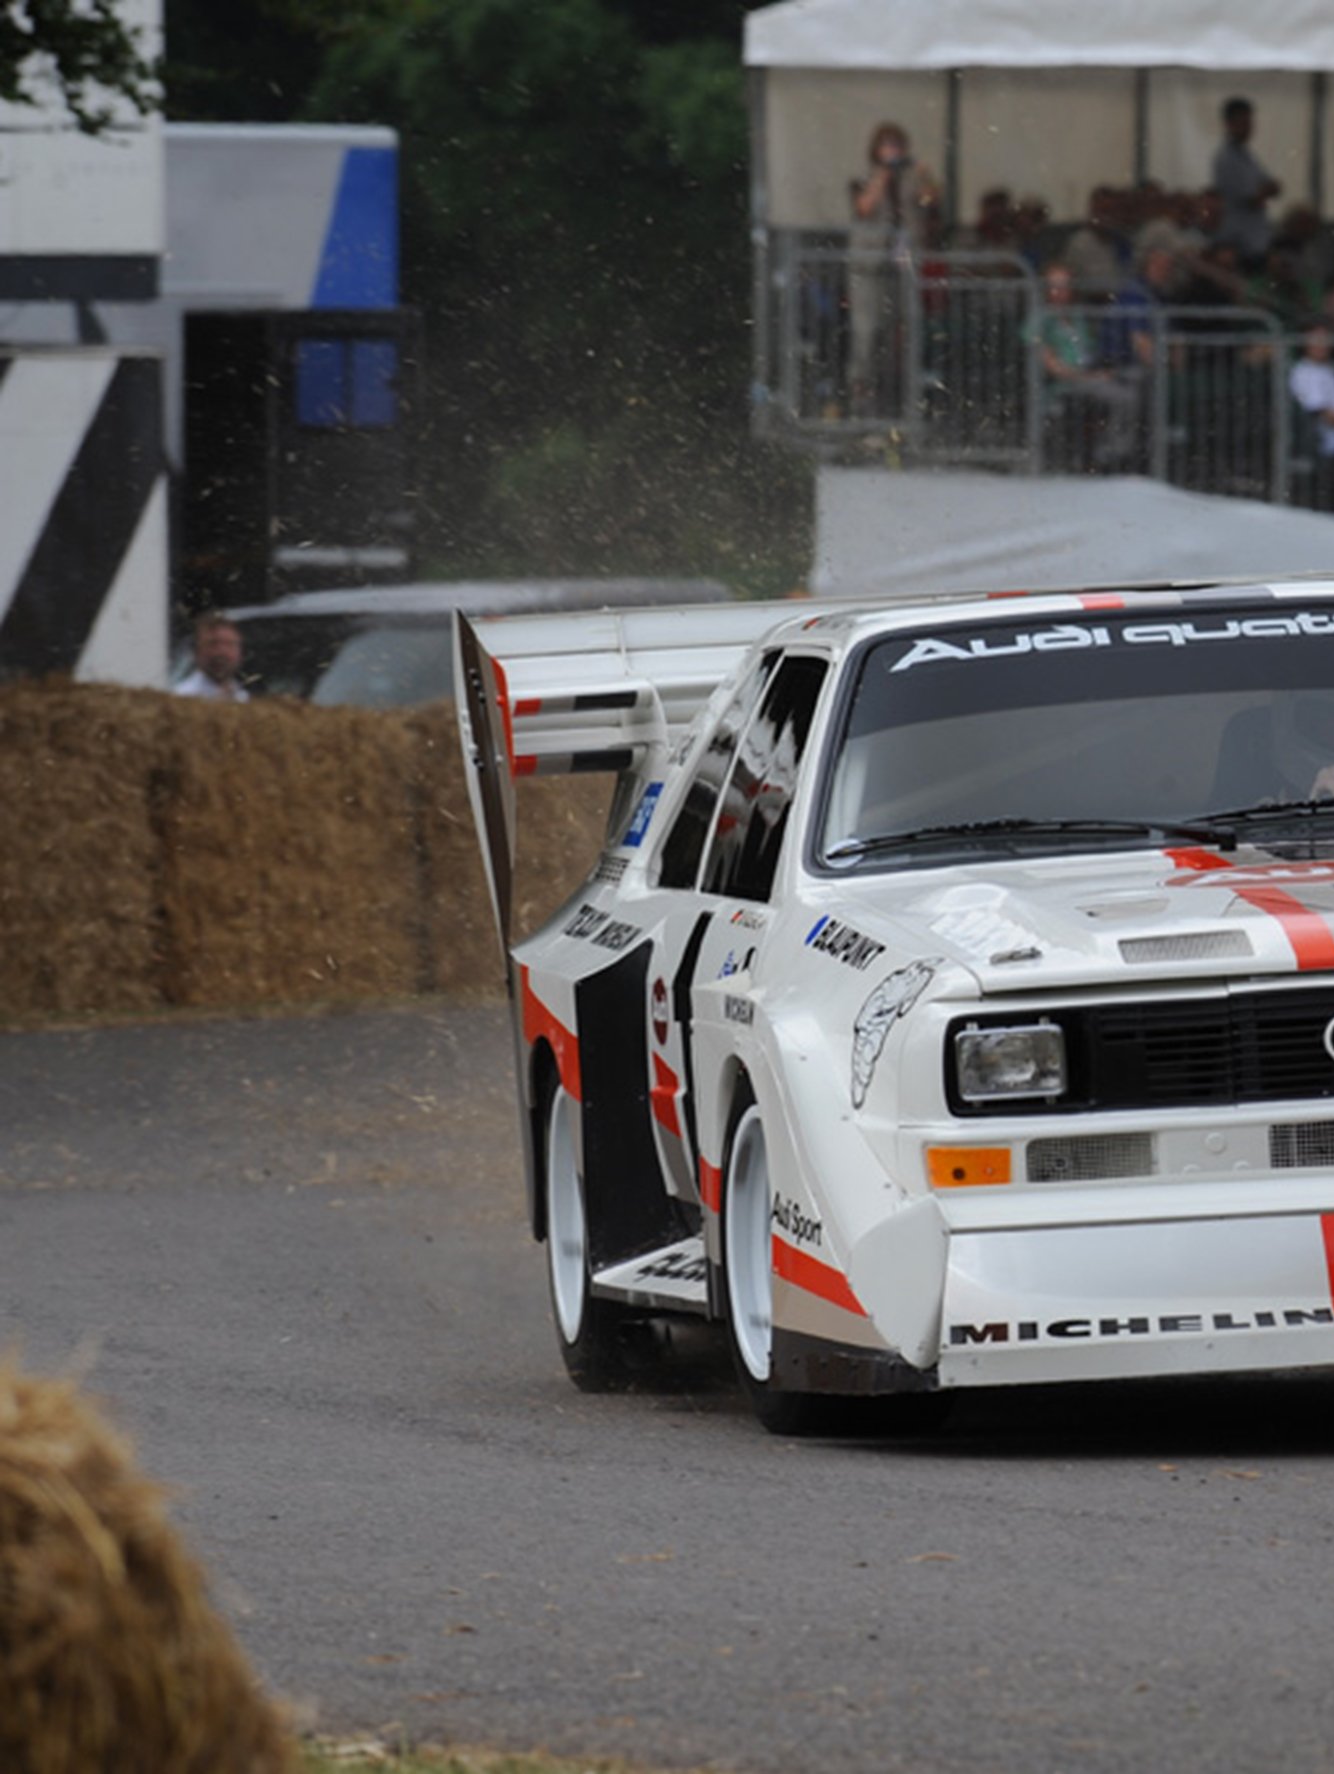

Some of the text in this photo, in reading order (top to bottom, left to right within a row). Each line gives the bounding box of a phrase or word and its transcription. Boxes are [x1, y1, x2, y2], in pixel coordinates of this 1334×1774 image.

[889, 624, 1109, 672] Audi
[811, 918, 887, 972] BLAUPUNKT
[770, 1190, 823, 1247] Audi Sport
[949, 1307, 1334, 1346] MICHELIN
